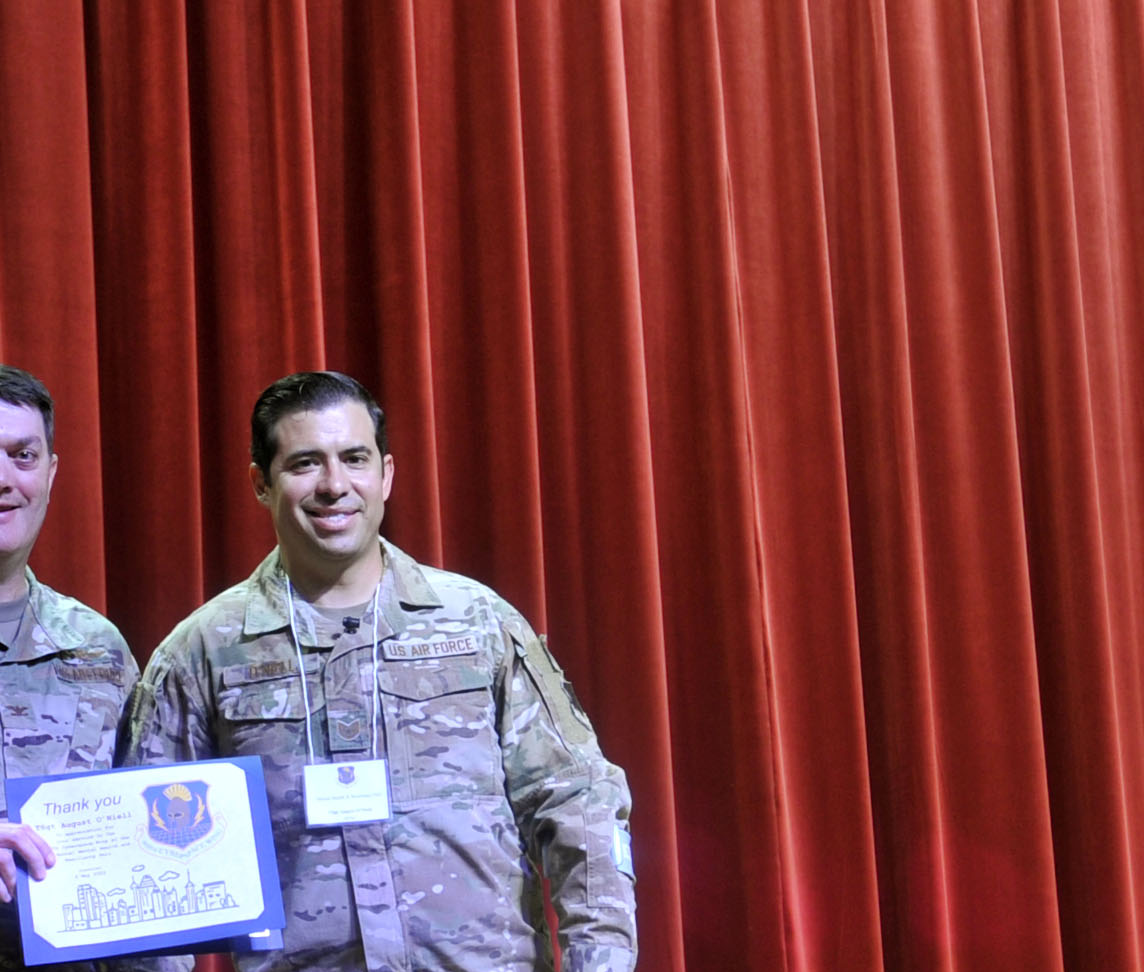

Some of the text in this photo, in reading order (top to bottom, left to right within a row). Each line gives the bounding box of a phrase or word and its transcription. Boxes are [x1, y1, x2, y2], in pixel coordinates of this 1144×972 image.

[411, 642, 430, 656] AIR
[433, 638, 474, 654] FORCE
[43, 795, 121, 816] Thank you
[61, 819, 91, 829] August
